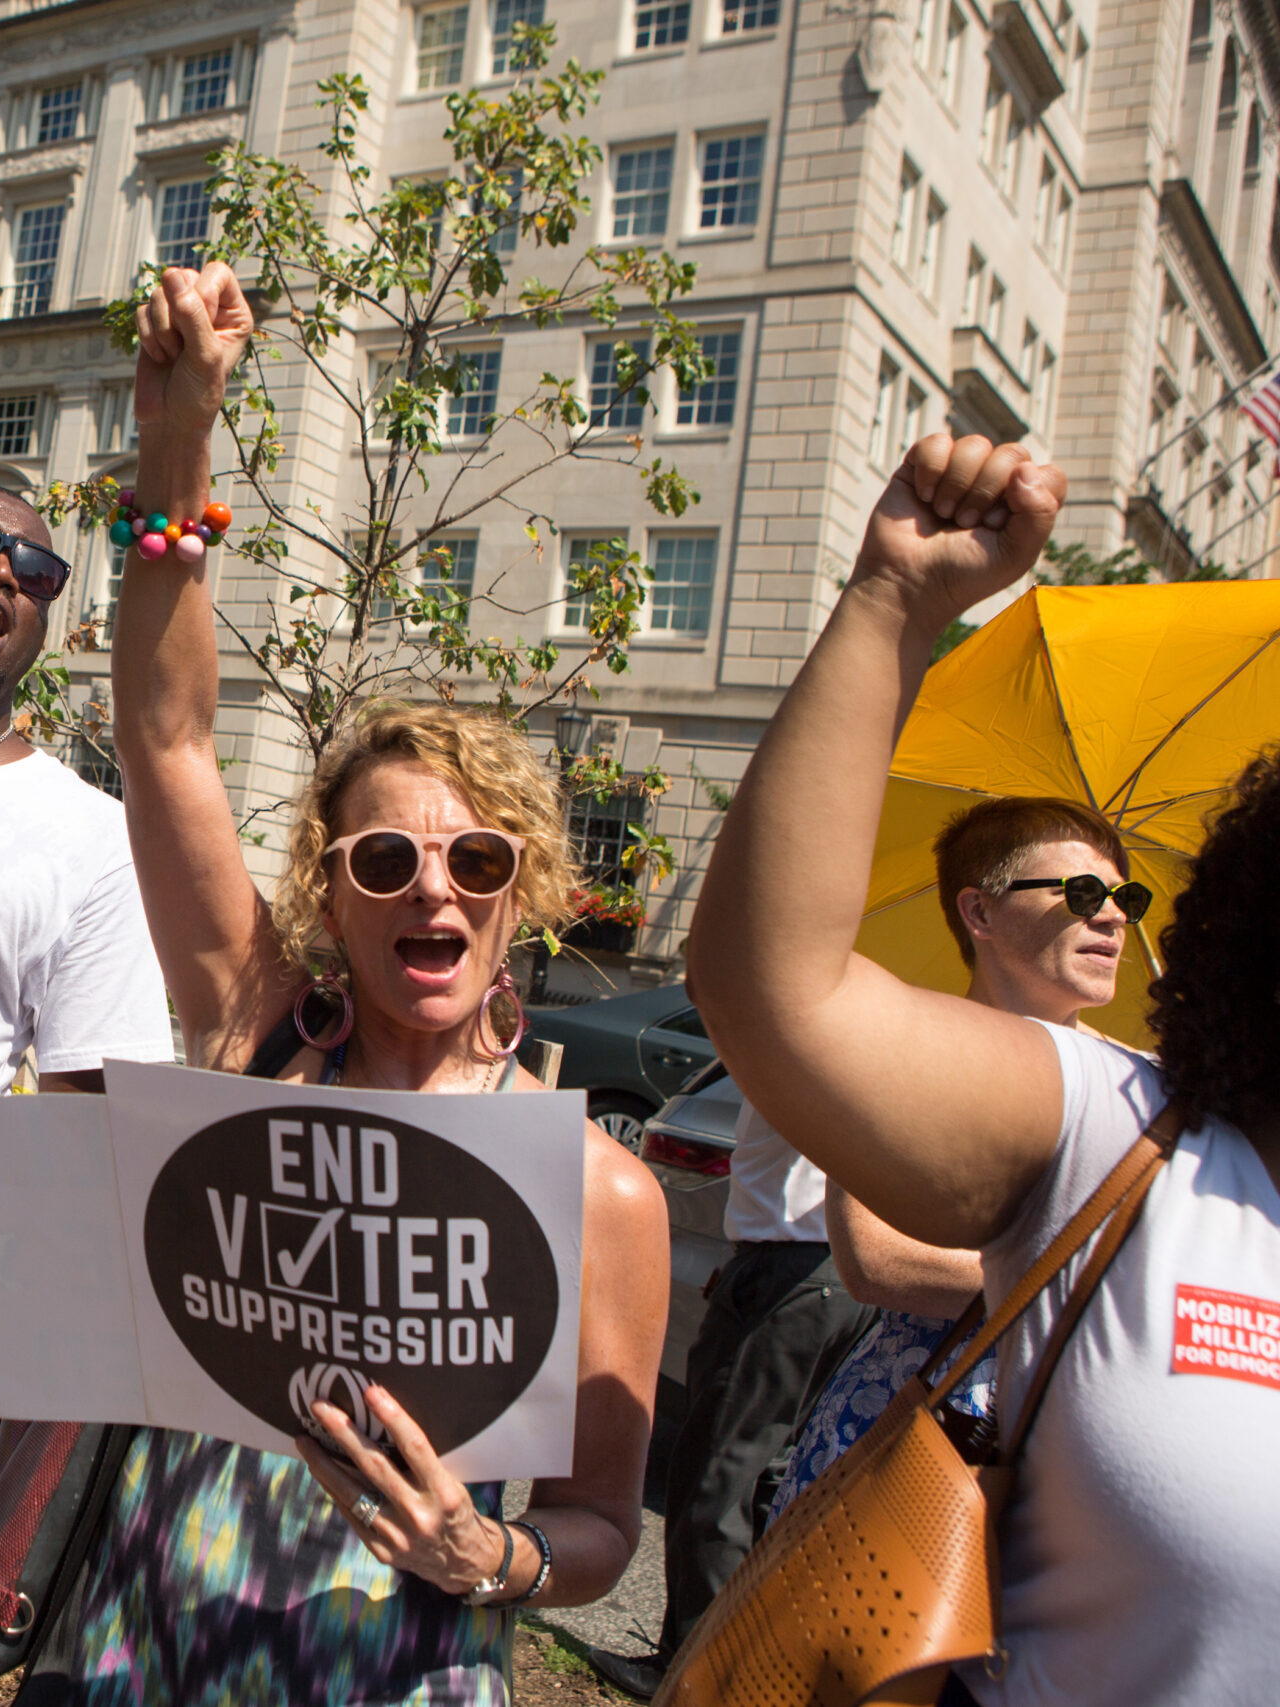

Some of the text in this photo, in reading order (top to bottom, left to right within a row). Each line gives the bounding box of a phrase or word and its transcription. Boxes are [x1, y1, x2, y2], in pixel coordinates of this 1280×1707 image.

[268, 1118, 400, 1208] END
[182, 1273, 515, 1366] SUPPRESSION
[1191, 1322, 1280, 1361] MILLIO
[1175, 1343, 1213, 1367] FOR
